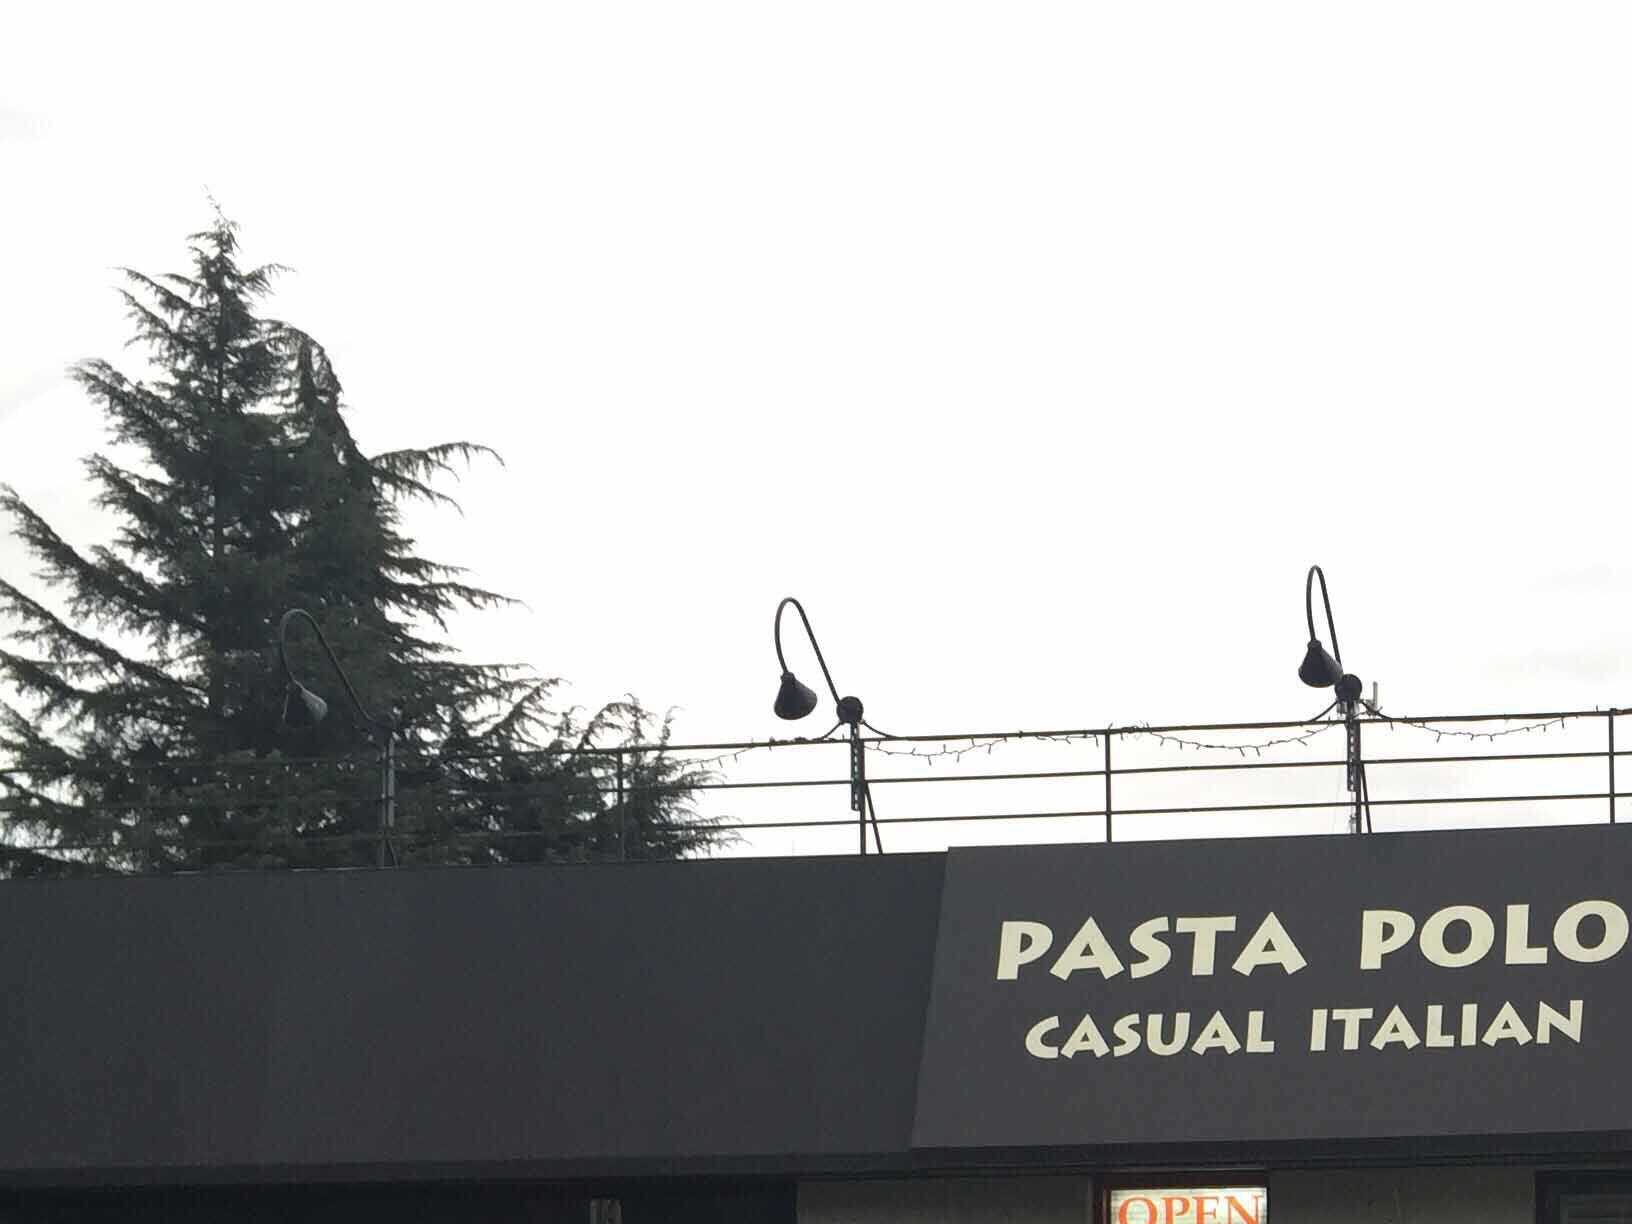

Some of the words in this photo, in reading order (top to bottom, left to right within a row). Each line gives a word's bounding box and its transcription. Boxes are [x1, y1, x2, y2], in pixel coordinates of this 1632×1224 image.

[996, 911, 1308, 982] PASTA
[1359, 899, 1631, 972] POLO
[1024, 1009, 1275, 1060] CASUAL
[1309, 999, 1584, 1052] ITALIAN
